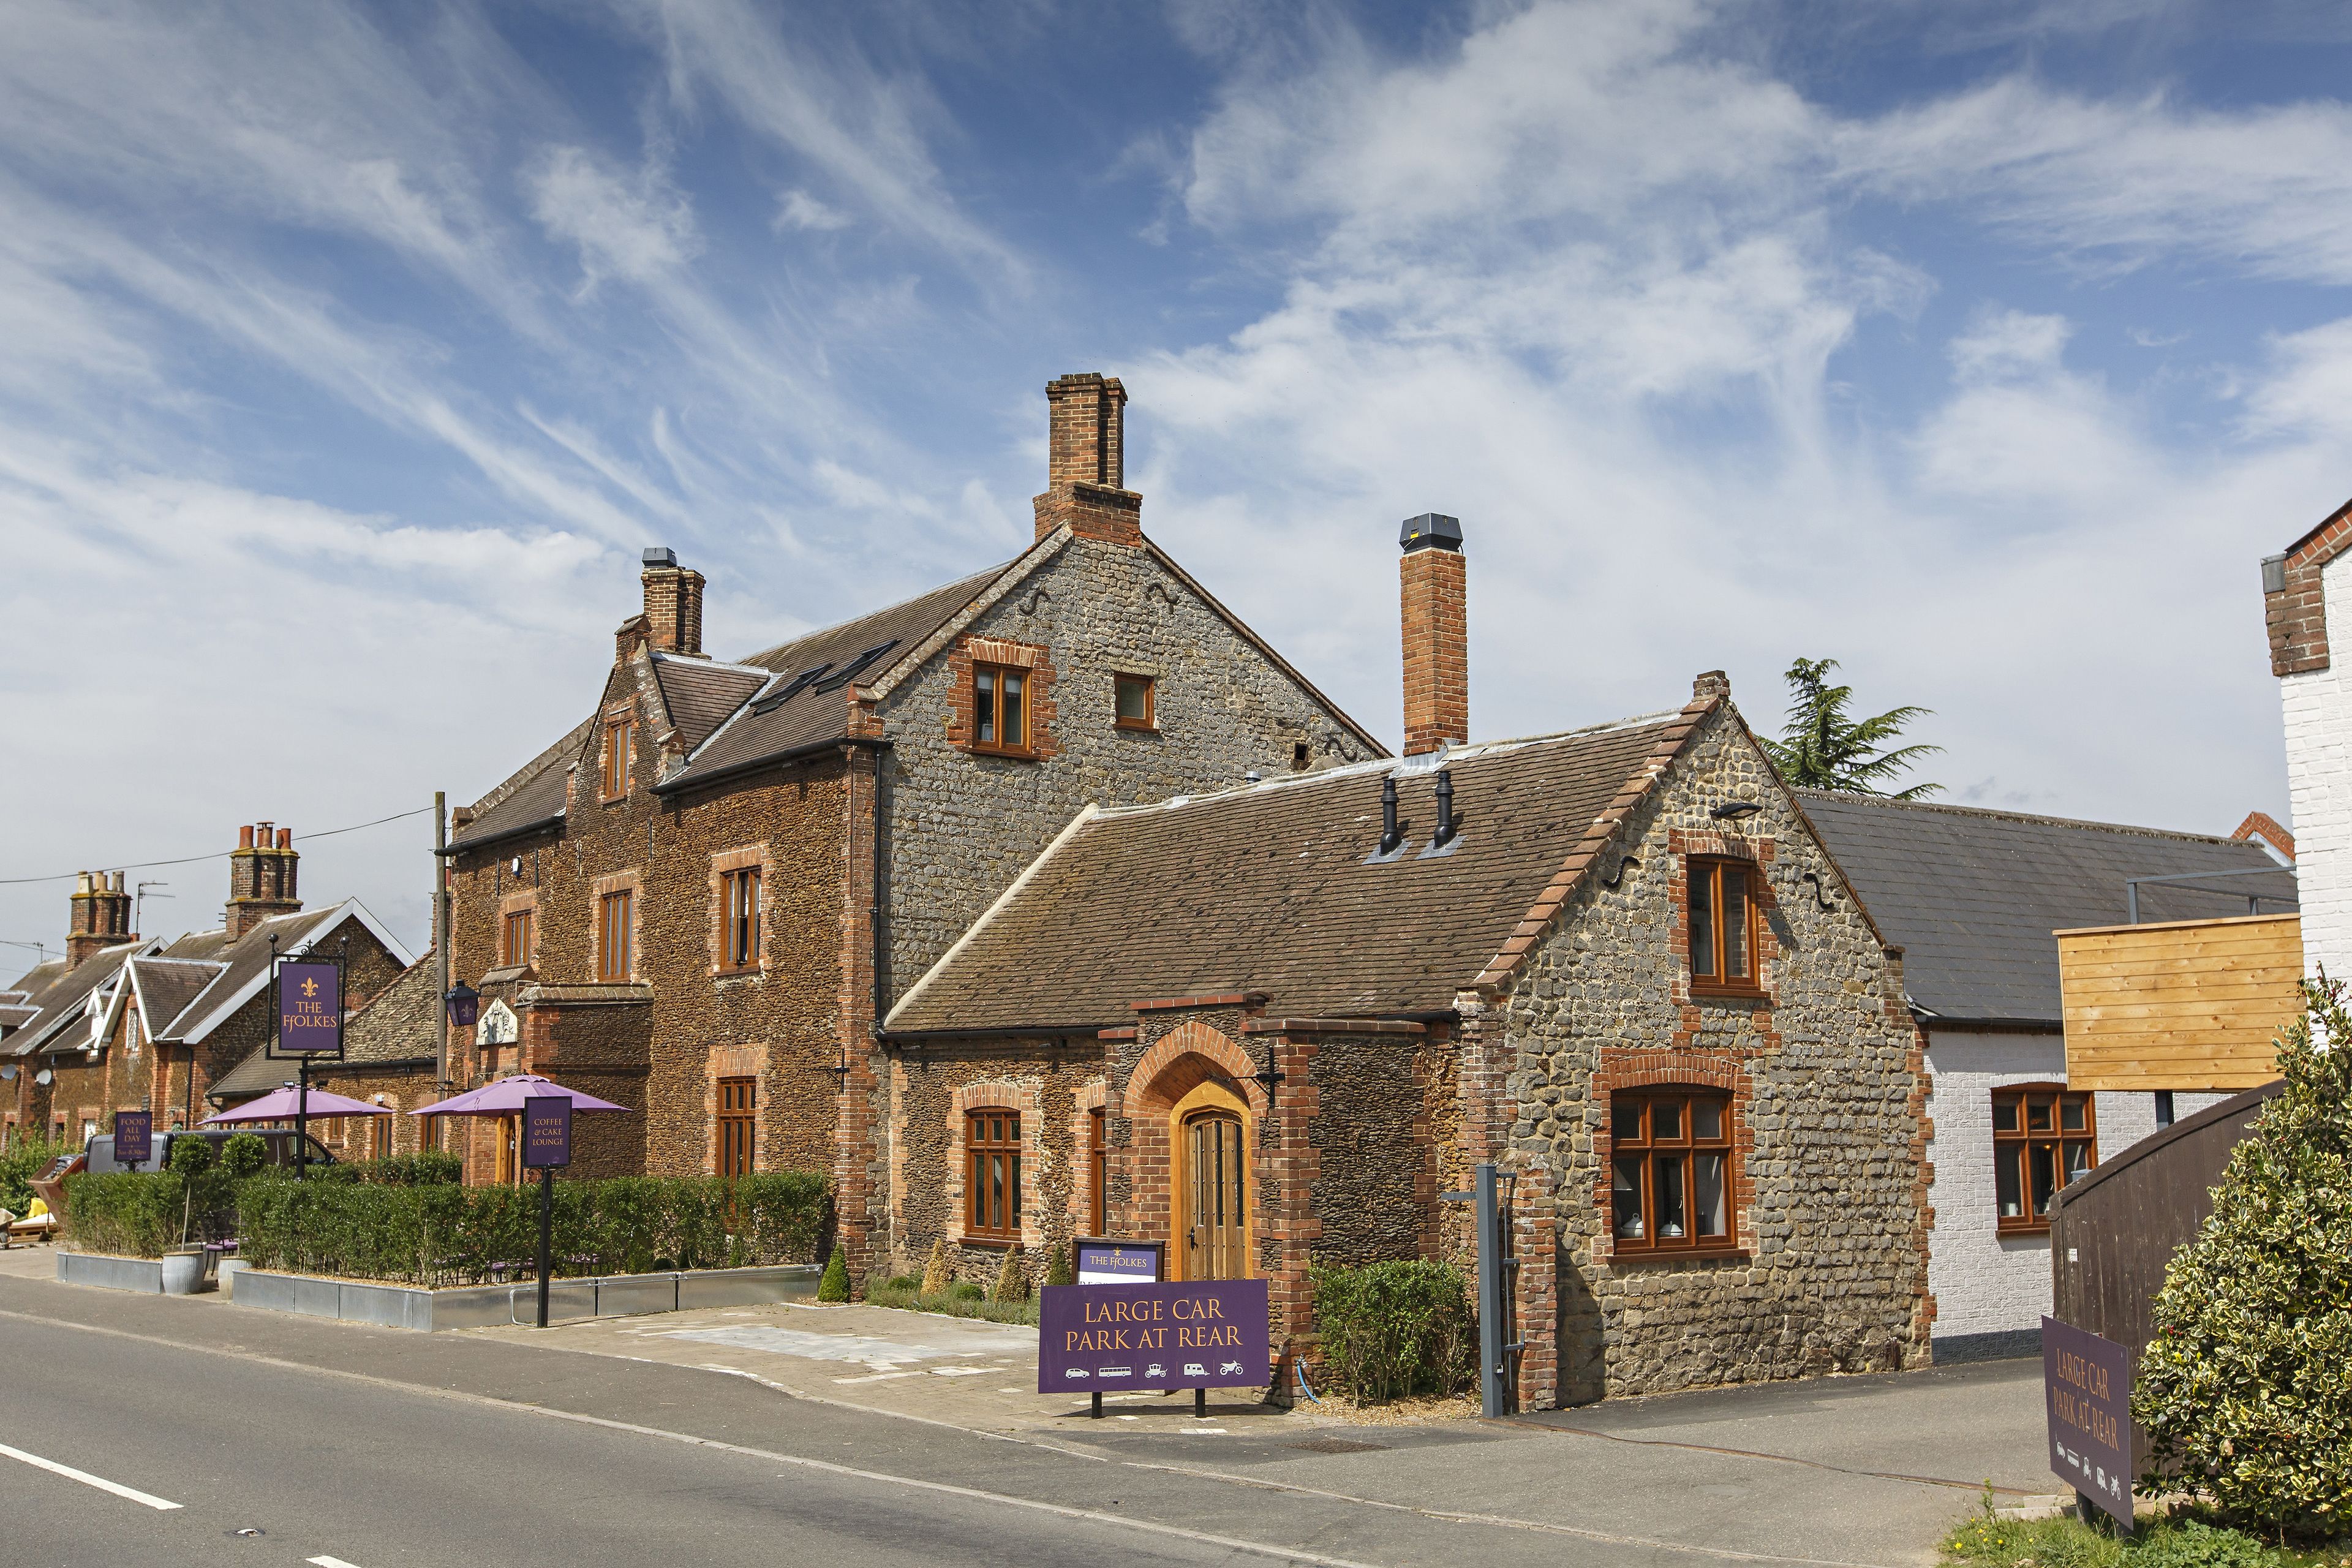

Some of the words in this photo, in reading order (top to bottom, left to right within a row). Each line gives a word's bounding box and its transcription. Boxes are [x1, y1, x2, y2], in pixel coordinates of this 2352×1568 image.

[296, 1001, 323, 1013] THE
[1090, 1256, 1108, 1265] THE
[1084, 1300, 1164, 1324] LARGE
[1172, 1298, 1225, 1320] CAR
[1065, 1329, 1132, 1352] PARK
[1137, 1327, 1169, 1349] AT
[1178, 1325, 1243, 1348] REAR
[2056, 1348, 2086, 1389] LARGE
[2088, 1362, 2110, 1402] CAR
[2053, 1386, 2077, 1427] PARK
[2078, 1401, 2089, 1433] AT
[2092, 1406, 2119, 1452] REAR
